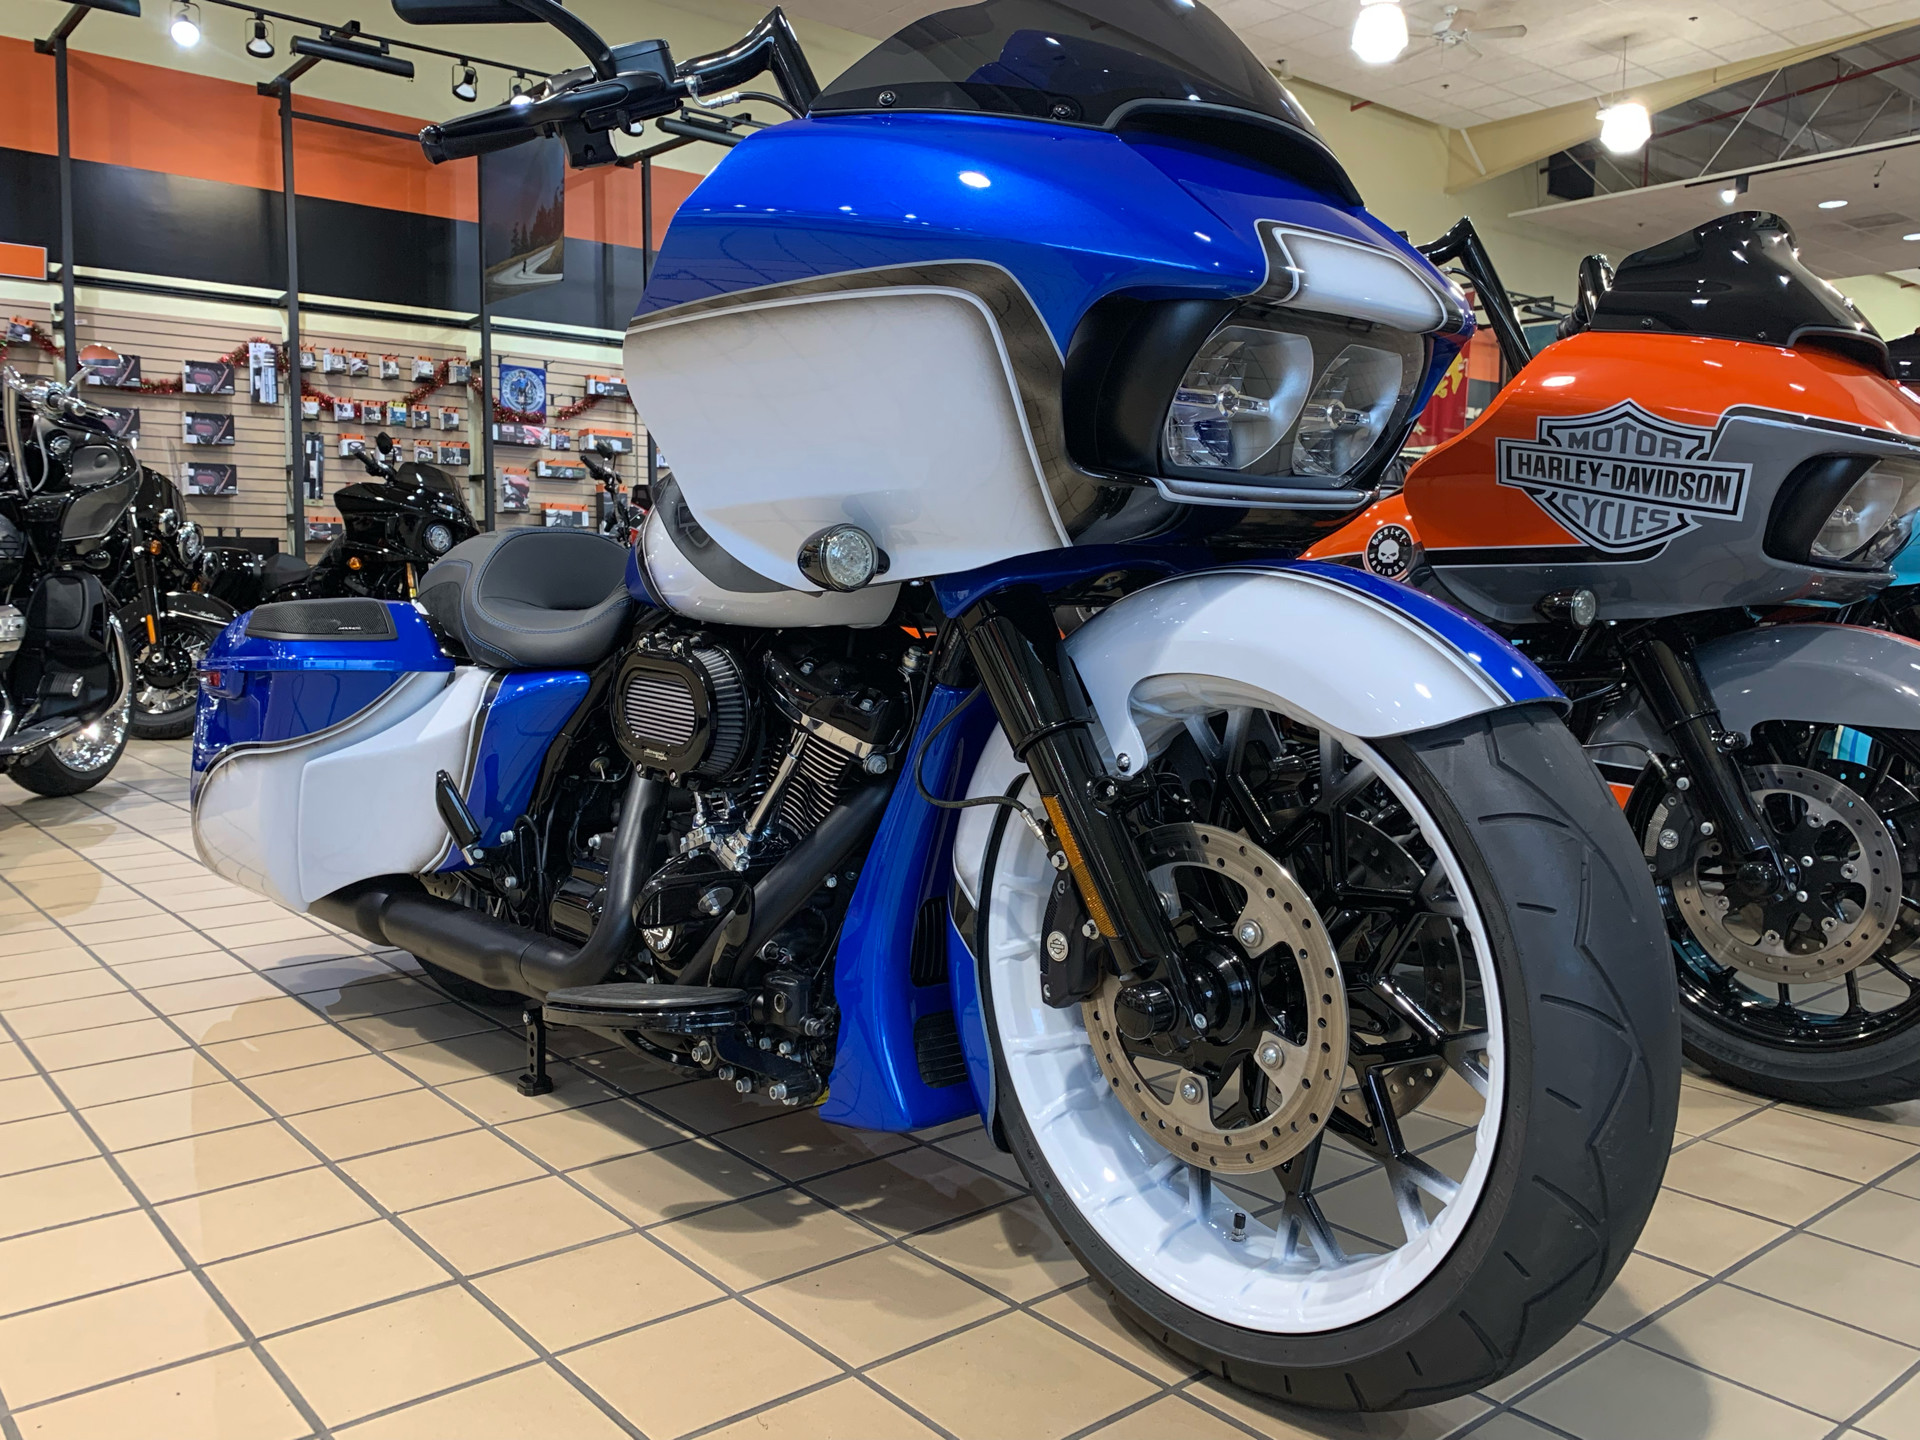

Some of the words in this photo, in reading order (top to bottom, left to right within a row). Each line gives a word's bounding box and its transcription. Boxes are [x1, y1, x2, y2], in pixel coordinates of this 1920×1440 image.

[1568, 422, 1682, 459] MOTOR
[1518, 452, 1732, 505] HARLEY-DAVIDSON
[1562, 493, 1670, 540] CYCLES
